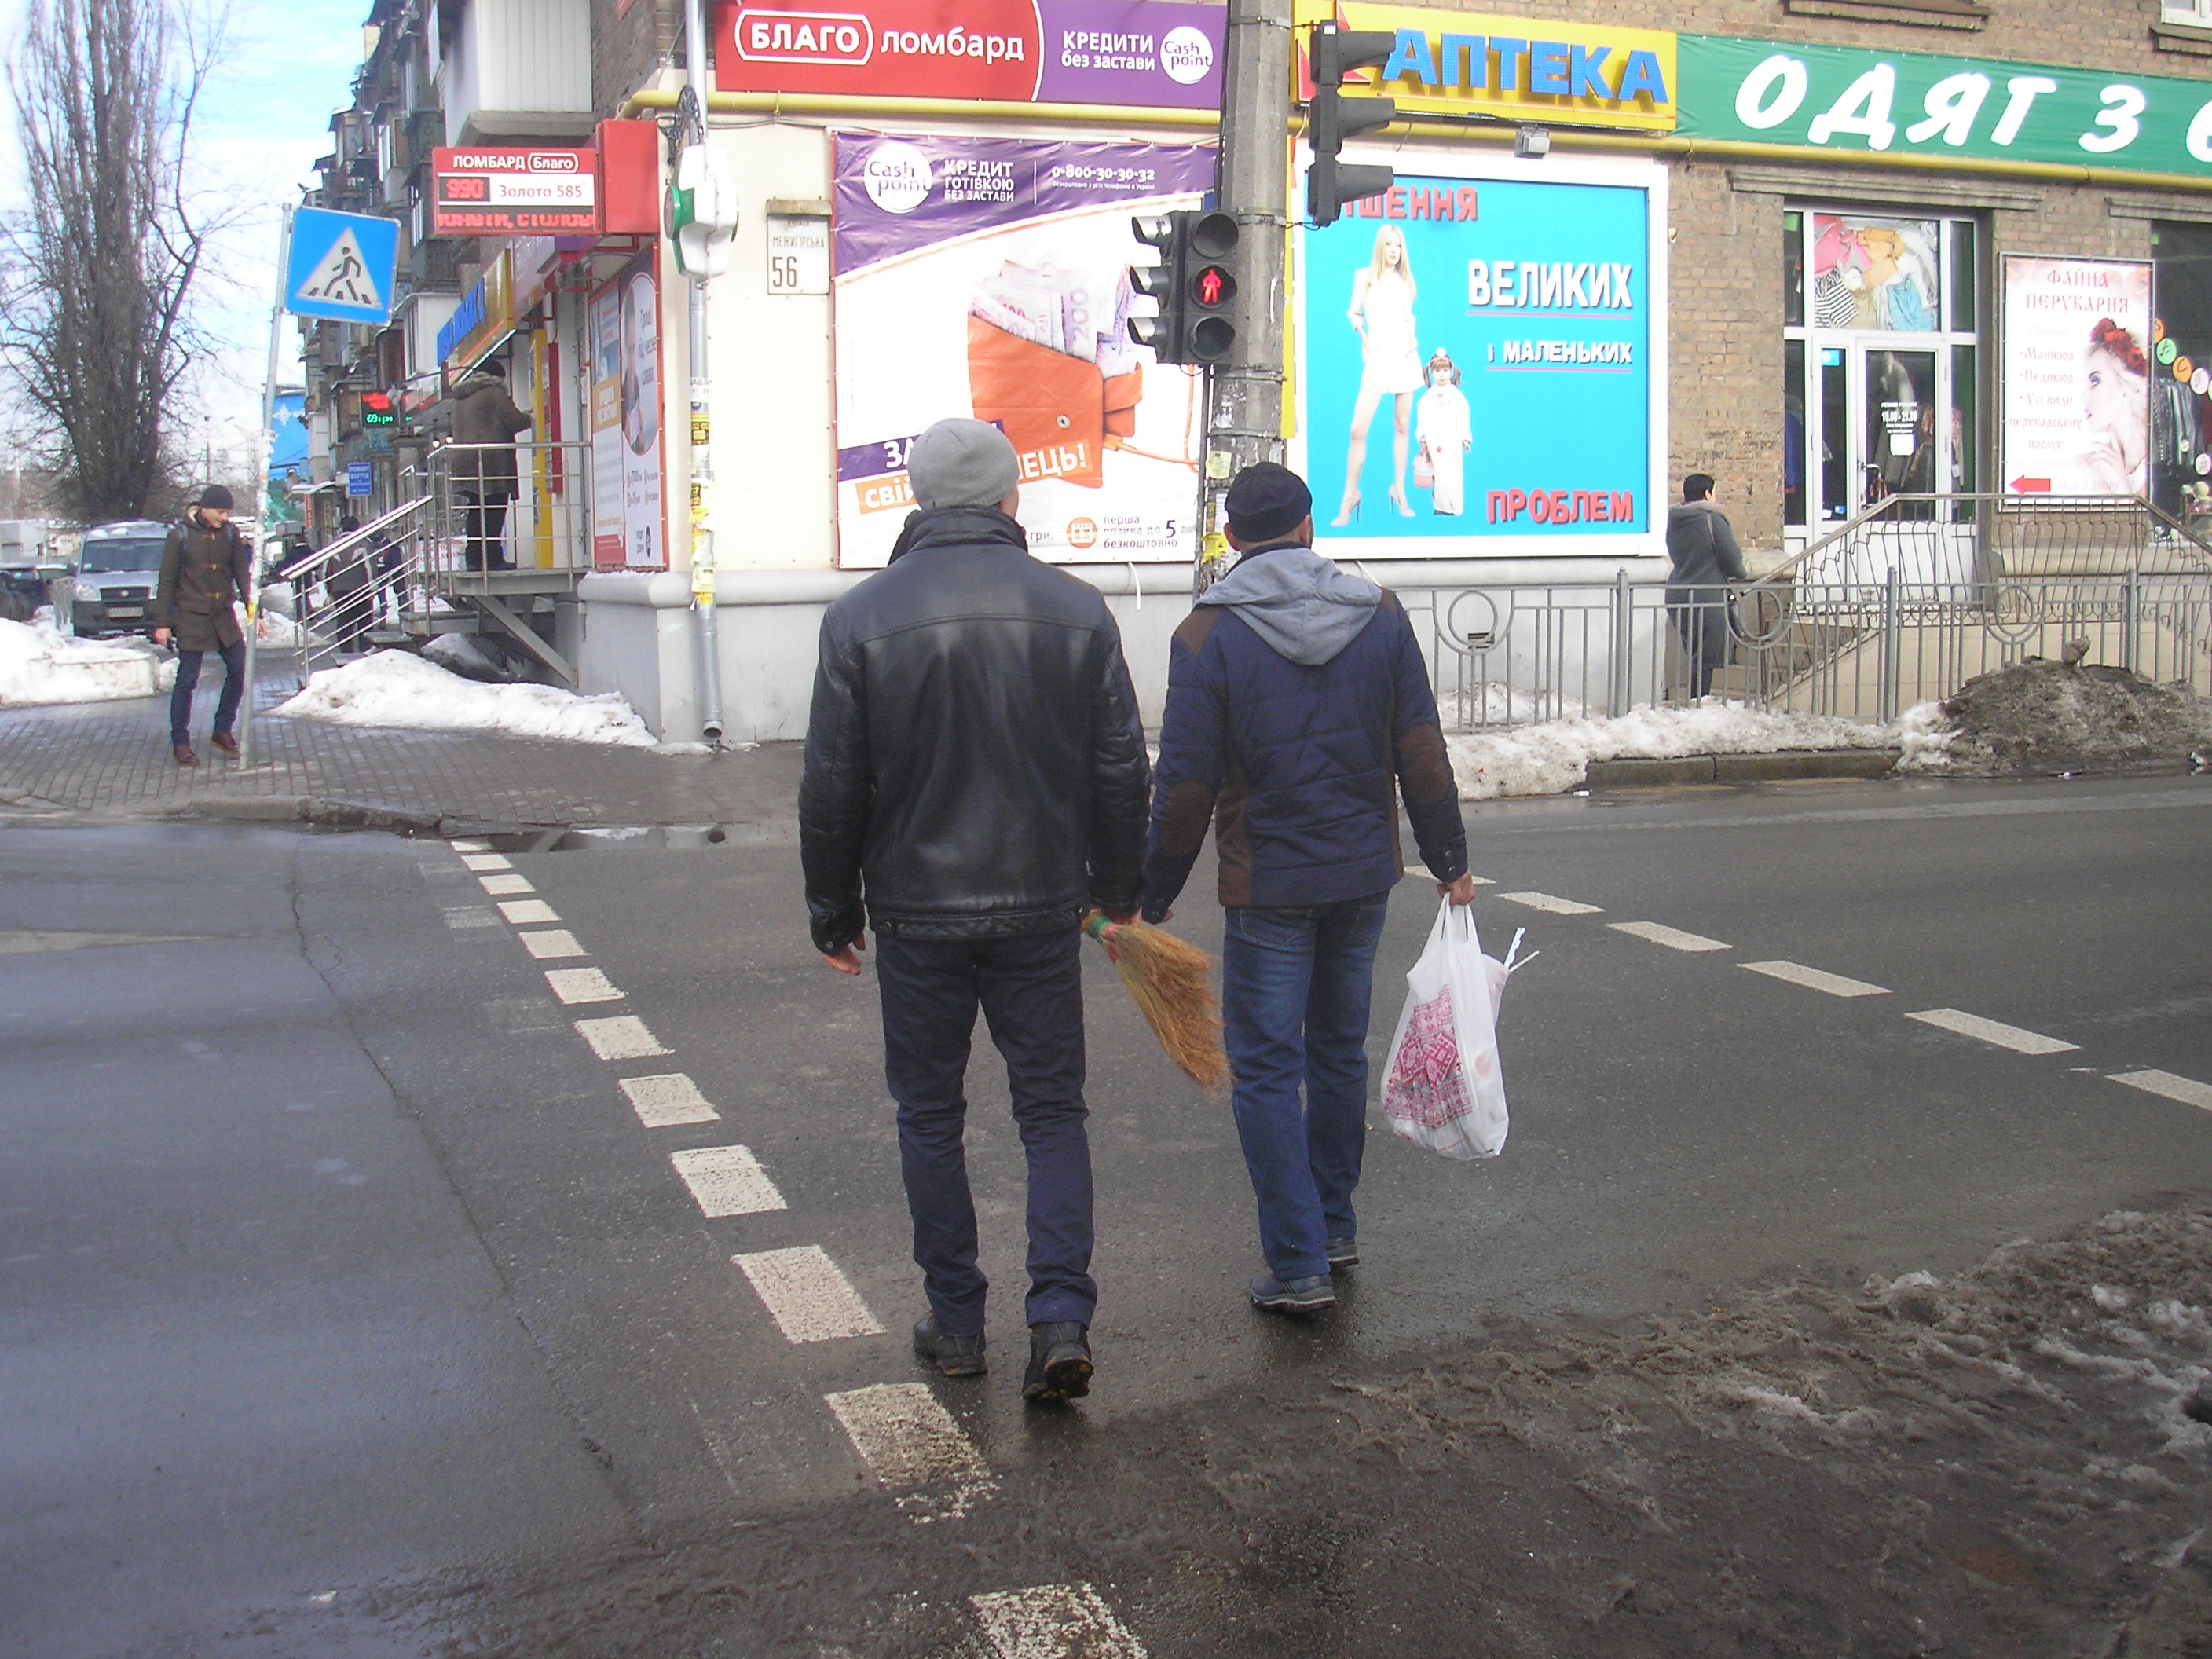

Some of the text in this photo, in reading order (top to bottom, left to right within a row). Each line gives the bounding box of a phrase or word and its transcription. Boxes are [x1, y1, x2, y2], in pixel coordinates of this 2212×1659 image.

[750, 24, 1024, 64] БЛАГО ломбард
[1062, 31, 1154, 54] КРЕДИТИ
[1164, 41, 1199, 55] Cash
[1060, 49, 1155, 71] без застави
[1170, 54, 1213, 71] point
[1382, 28, 1669, 104] АПТЕКА
[1734, 53, 2058, 151] ОДЯГ
[2078, 83, 2147, 153] З
[452, 156, 573, 170] ЛОМБАРД Благо
[869, 160, 915, 178] Cash
[944, 159, 1014, 178] КРЕДИТ
[1051, 163, 1155, 183] 0-800-30-30-32
[499, 185, 583, 198] Золото 585
[878, 178, 931, 197] point
[944, 177, 1015, 191] ГОТІВКОЮ
[944, 189, 1014, 202] БЕЗ ЗАСТАВИ
[772, 256, 797, 287] 56
[2047, 267, 2109, 288] ФАЙНА
[1467, 259, 1633, 309] ВЕЛИКИХ
[1487, 340, 1633, 364] і МАЛЕНЬКИХ
[1487, 489, 1633, 524] ПРОБЛЕМ
[1103, 516, 1141, 526] перша
[1147, 526, 1161, 536] до
[1166, 519, 1176, 539] 5
[1030, 530, 1054, 540] грн.
[1103, 537, 1178, 548] безкоштовно
